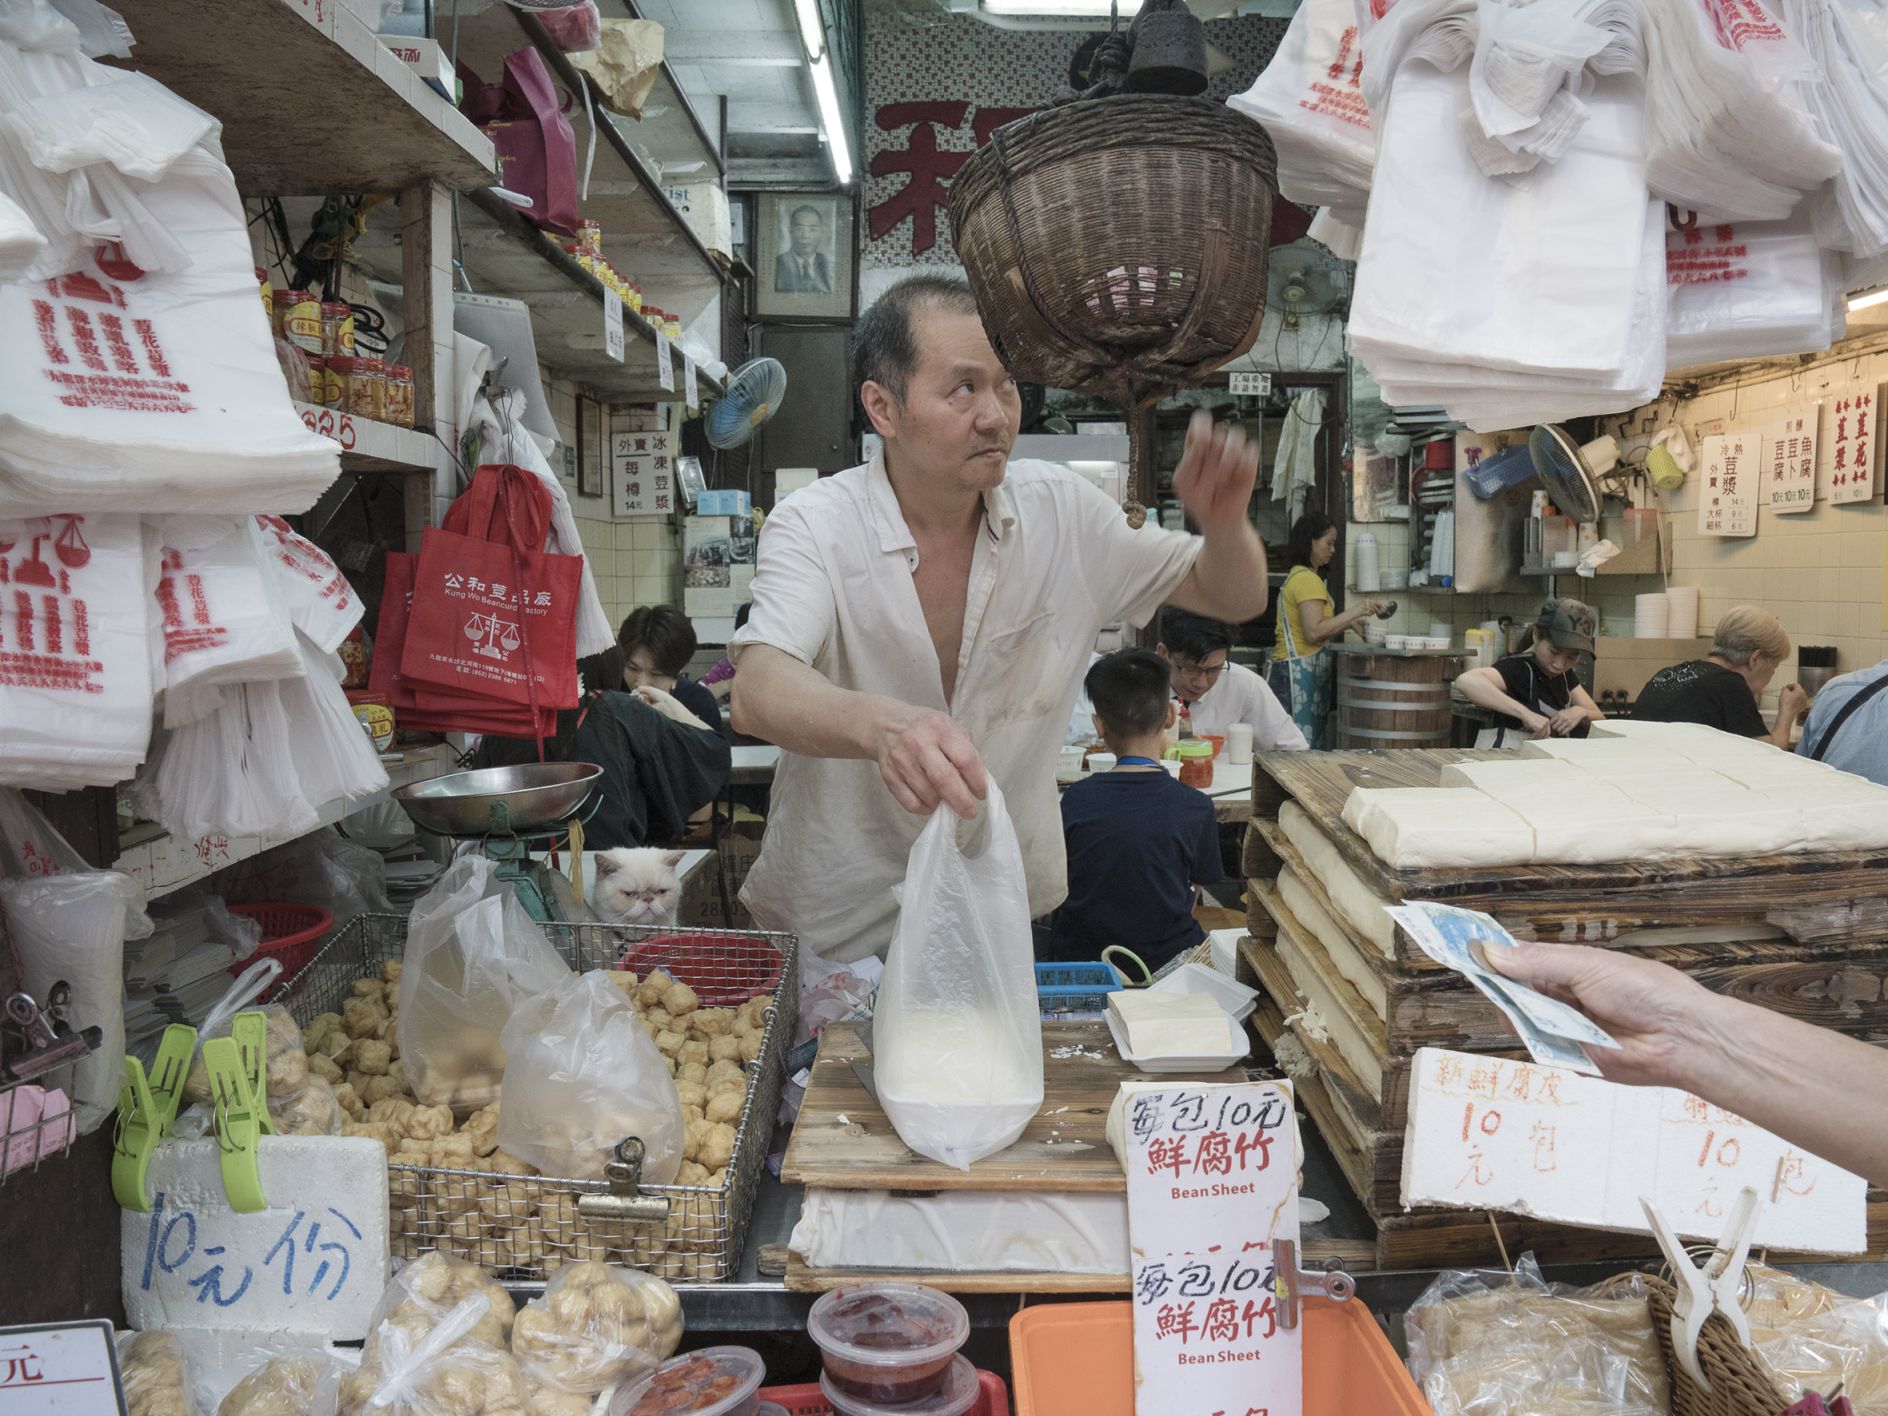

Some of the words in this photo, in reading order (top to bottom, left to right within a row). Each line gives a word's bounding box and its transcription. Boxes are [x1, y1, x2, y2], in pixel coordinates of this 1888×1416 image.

[619, 438, 647, 452] 外賣
[445, 588, 466, 600] Kung
[468, 592, 480, 601] Wo
[481, 596, 518, 611] Beancurd
[523, 606, 548, 616] actory
[1462, 1102, 1502, 1142] 10
[1147, 1128, 1274, 1179] 鮮腐竹
[1454, 1144, 1494, 1190] 元
[1697, 1130, 1742, 1169] 10
[1171, 1187, 1209, 1199] Bean
[1211, 1182, 1255, 1196] Sheet
[1156, 1296, 1276, 1345] 鮮腐竹
[1178, 1353, 1215, 1365] Bean
[1218, 1349, 1261, 1362] Sheet
